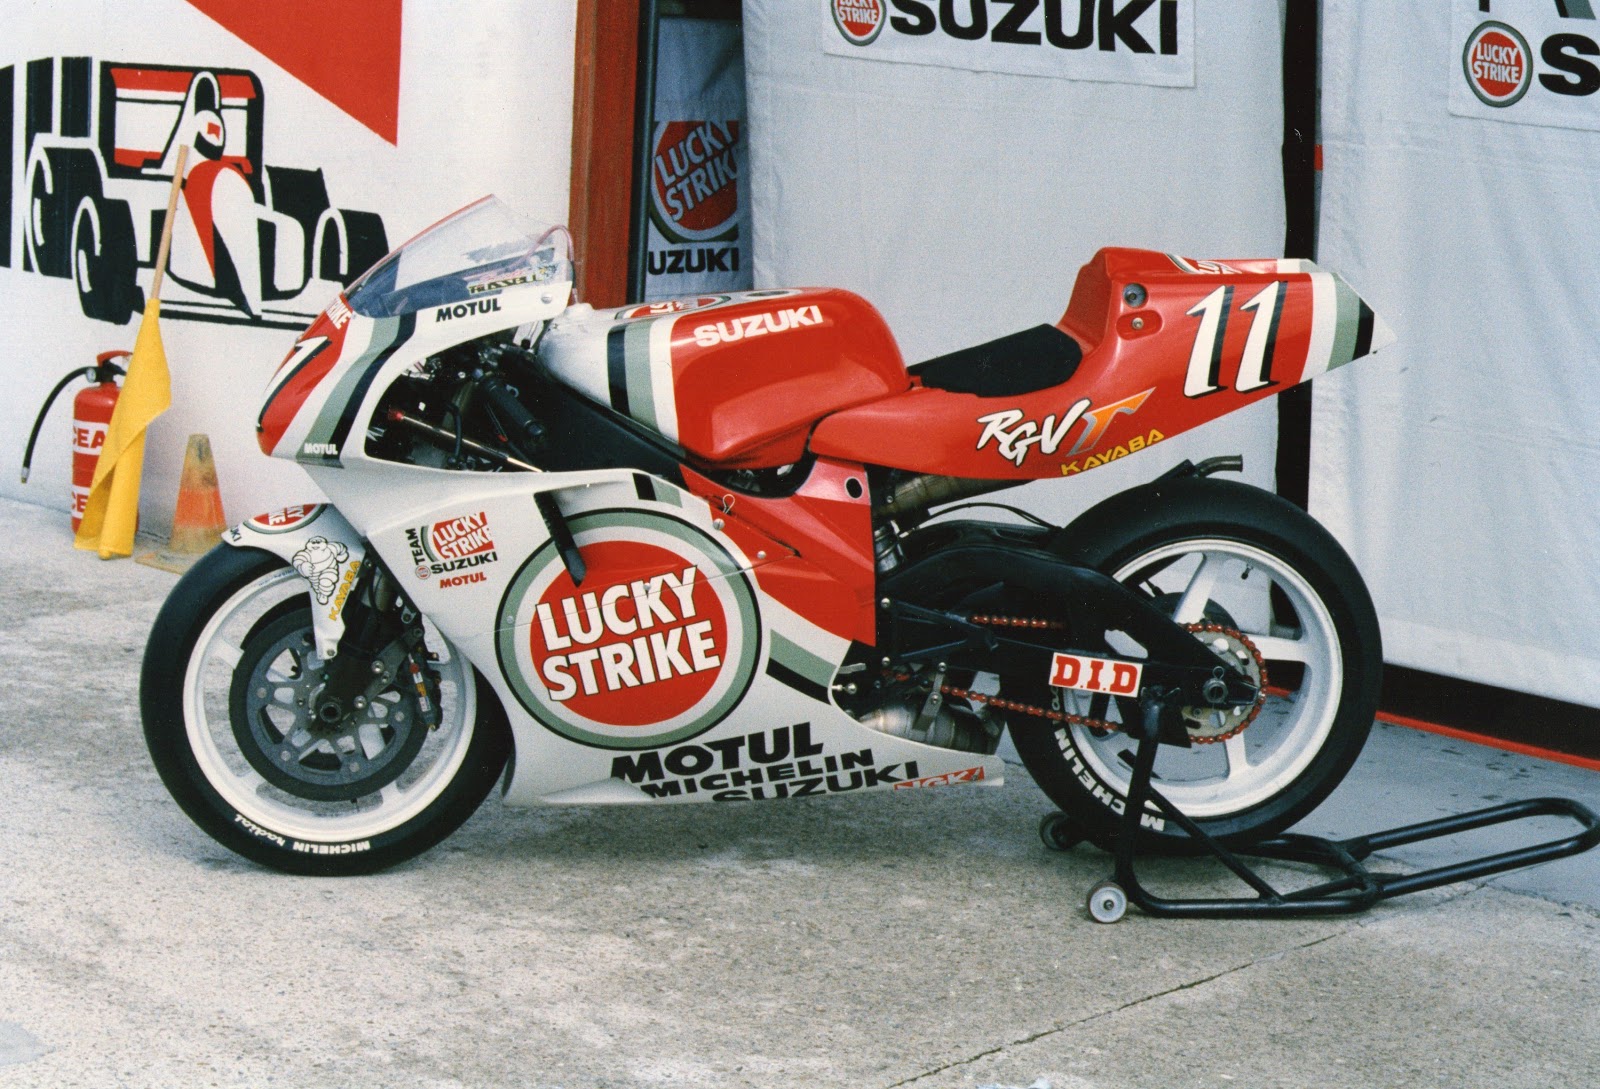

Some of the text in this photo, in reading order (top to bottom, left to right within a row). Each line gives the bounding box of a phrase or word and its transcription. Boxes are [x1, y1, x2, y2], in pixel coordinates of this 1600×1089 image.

[839, 6, 877, 25] STRIKE
[889, 0, 1179, 55] SUZUKI
[1473, 60, 1520, 84] STRIKE
[1476, 41, 1519, 66] LUCKY
[656, 121, 733, 187] LUCKY
[436, 298, 501, 322] MOTUL
[694, 305, 823, 347] SUZUKI
[1184, 280, 1288, 398] 11
[304, 443, 338, 455] MOTUL
[977, 398, 1092, 468] RGV
[1061, 428, 1164, 476] KAYABA
[405, 528, 425, 565] TEAM
[433, 513, 484, 546] LUCKY
[441, 525, 493, 560] STRIKE
[430, 551, 498, 574] SUZUKI
[440, 572, 487, 588] MOTUL
[329, 561, 360, 621] KAYABA
[536, 565, 697, 651] LUCKY
[542, 620, 721, 701] STRIKE
[1052, 655, 1139, 694] D.I.D
[611, 722, 824, 783] MOTUL
[640, 749, 874, 798] MICHELIN
[713, 761, 919, 801] SUZUKI
[1055, 728, 1165, 831] MCHELIN
[293, 840, 371, 855] MICHELIN
